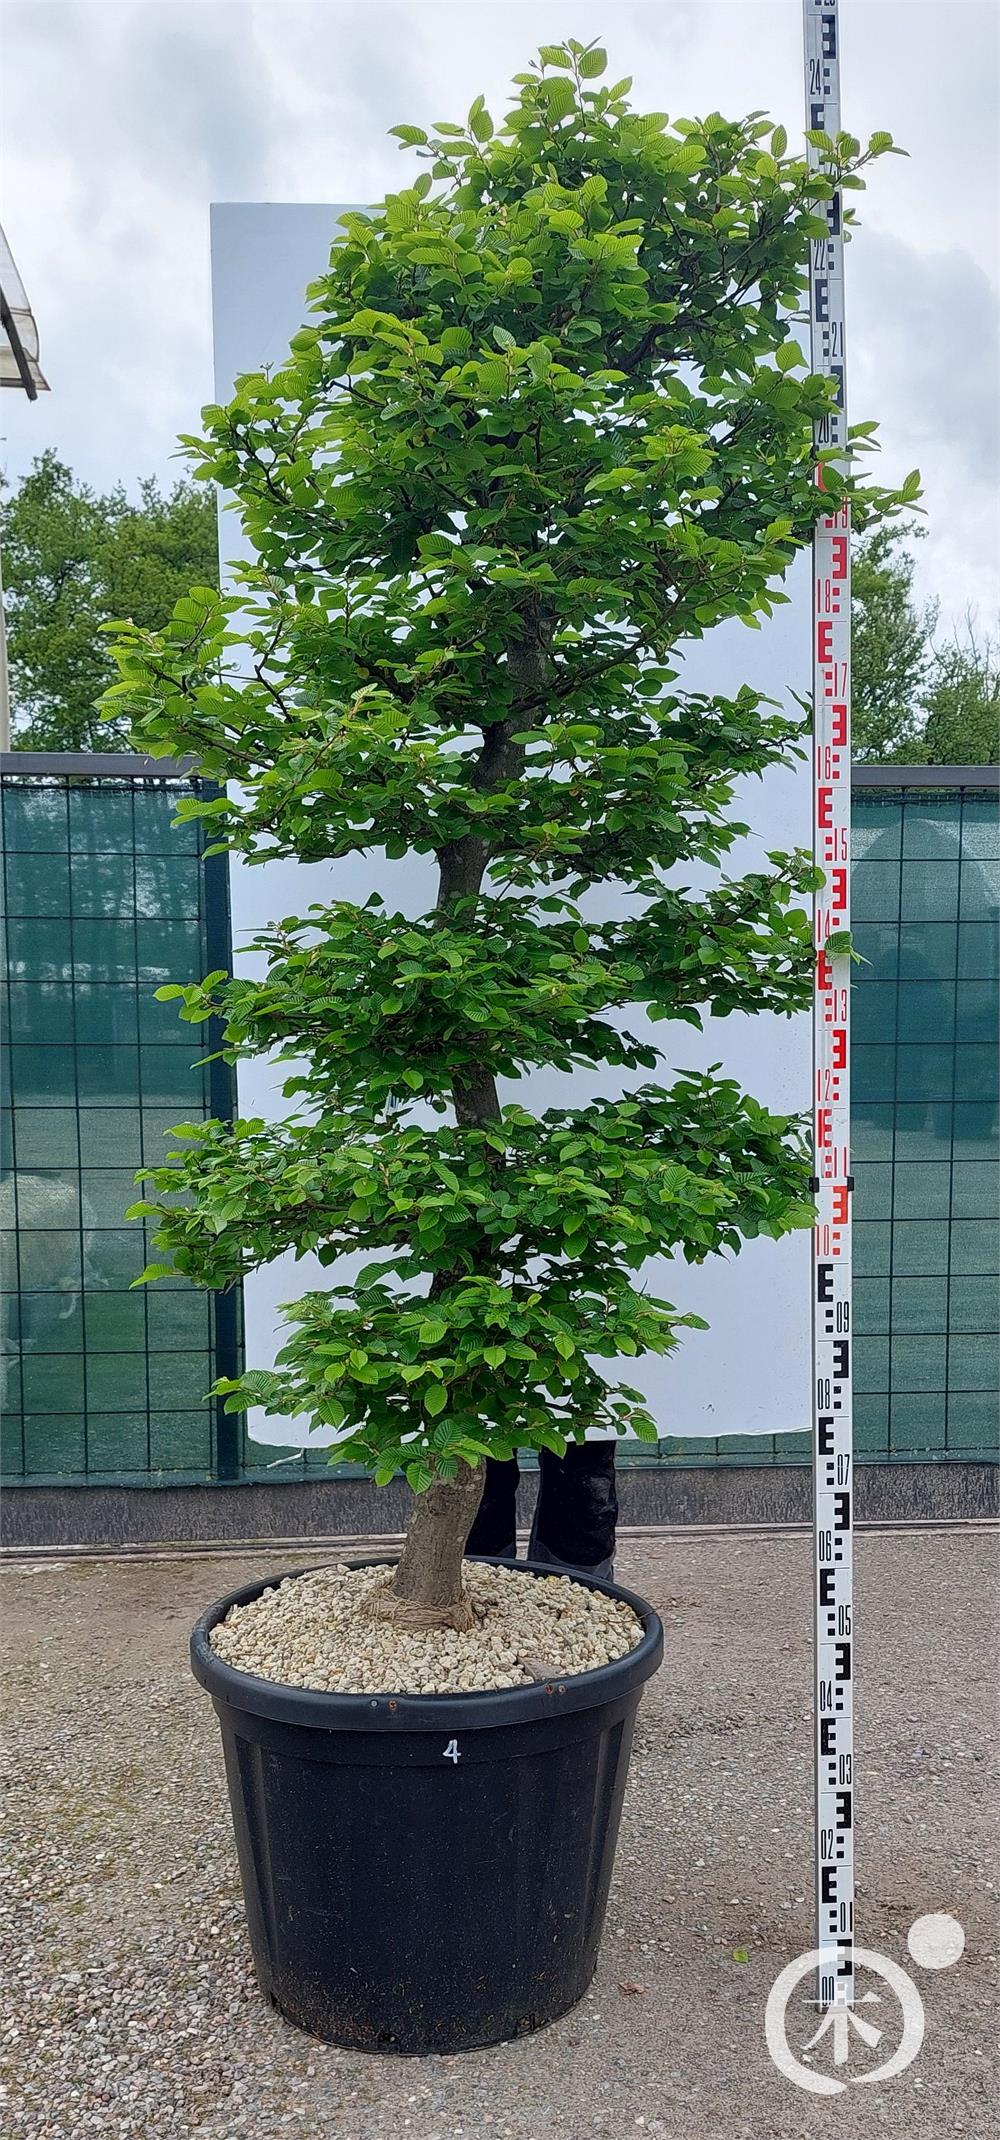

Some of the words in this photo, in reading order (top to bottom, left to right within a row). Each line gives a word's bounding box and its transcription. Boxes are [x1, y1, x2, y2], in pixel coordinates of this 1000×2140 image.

[810, 59, 821, 95] 24
[814, 238, 826, 271] 22
[832, 321, 843, 357] 21
[818, 412, 829, 444] 20
[817, 579, 830, 613] 18
[834, 662, 847, 697] 17
[818, 746, 830, 780] 16
[834, 828, 847, 861] 15
[818, 909, 830, 943] 14
[834, 989, 847, 1022] 13
[818, 1069, 830, 1101] 12
[834, 1147, 846, 1178] 11
[817, 1224, 829, 1256] 10
[836, 1301, 849, 1333] 09
[818, 1378, 830, 1409] 08
[838, 1454, 850, 1485] 07
[819, 1530, 831, 1561] 06
[839, 1605, 851, 1636] 05
[820, 1681, 832, 1711] 04
[443, 1739, 461, 1764] 4
[840, 1754, 851, 1785] 03
[821, 1829, 833, 1859] 02
[840, 1902, 852, 1932] 01
[822, 1976, 834, 2006] 00
